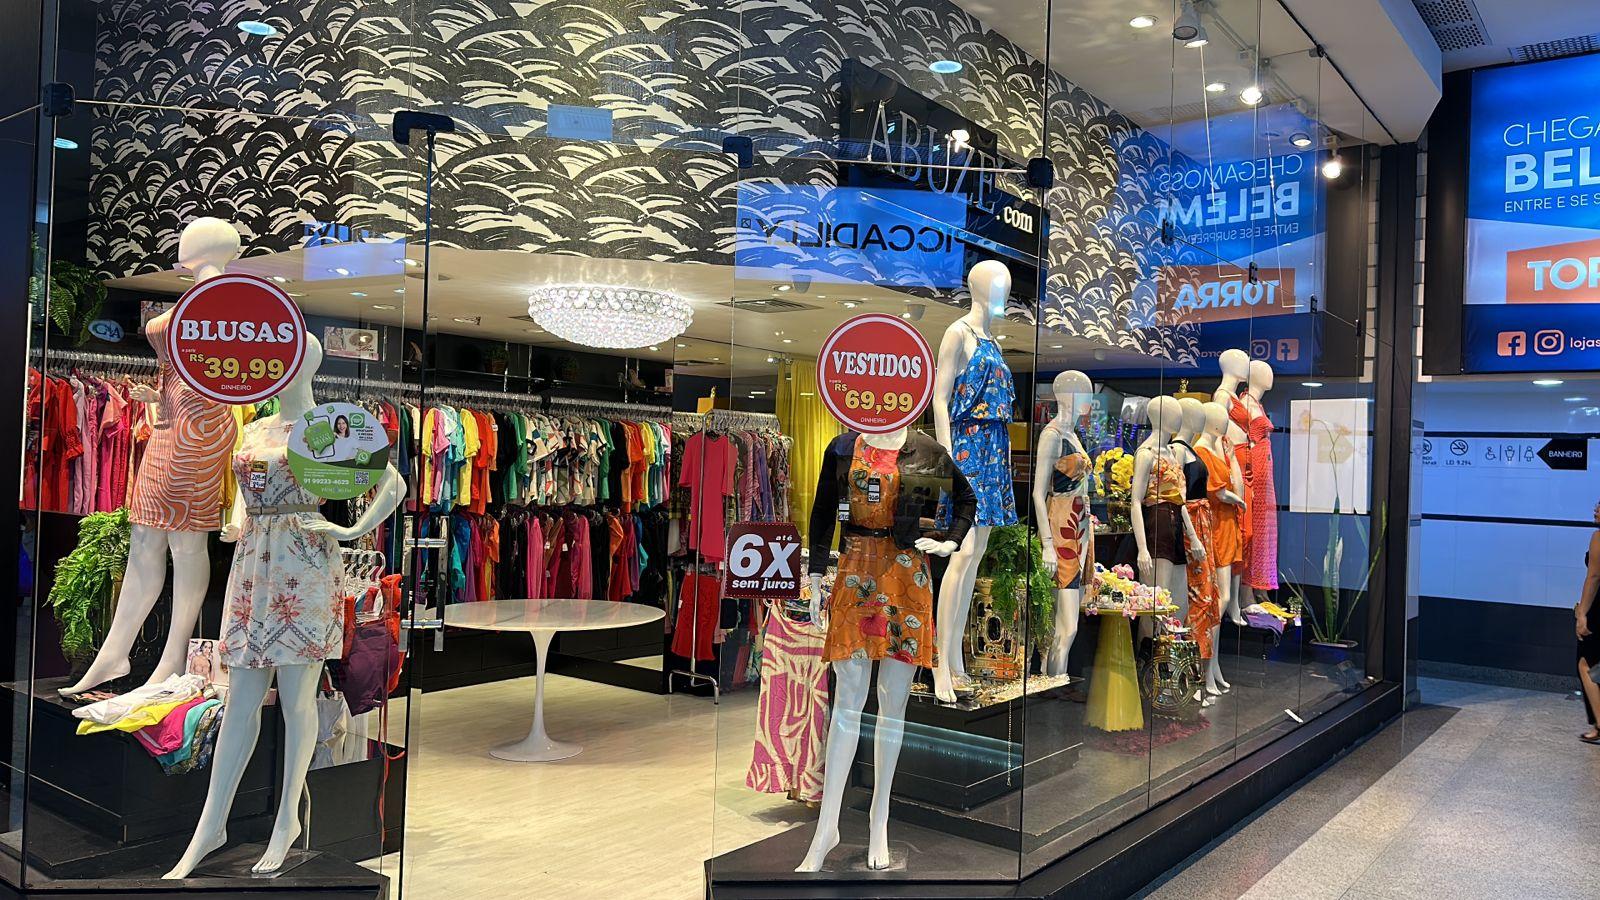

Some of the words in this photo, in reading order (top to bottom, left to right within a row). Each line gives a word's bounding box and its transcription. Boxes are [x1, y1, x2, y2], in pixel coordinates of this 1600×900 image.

[866, 100, 996, 214] ABUZE
[1505, 146, 1600, 194] BEL
[1504, 197, 1552, 213] ENTRE
[1557, 197, 1566, 208] E
[1570, 194, 1589, 207] SE
[180, 319, 294, 343] BLUSAS
[203, 357, 285, 383] 39,99
[832, 350, 922, 379] VESTIDOS
[845, 390, 914, 415] 69,99
[860, 416, 887, 424] DINHEIRO
[1548, 450, 1583, 458] BANHEIRO
[731, 579, 760, 589] sem
[761, 578, 796, 591] juros
